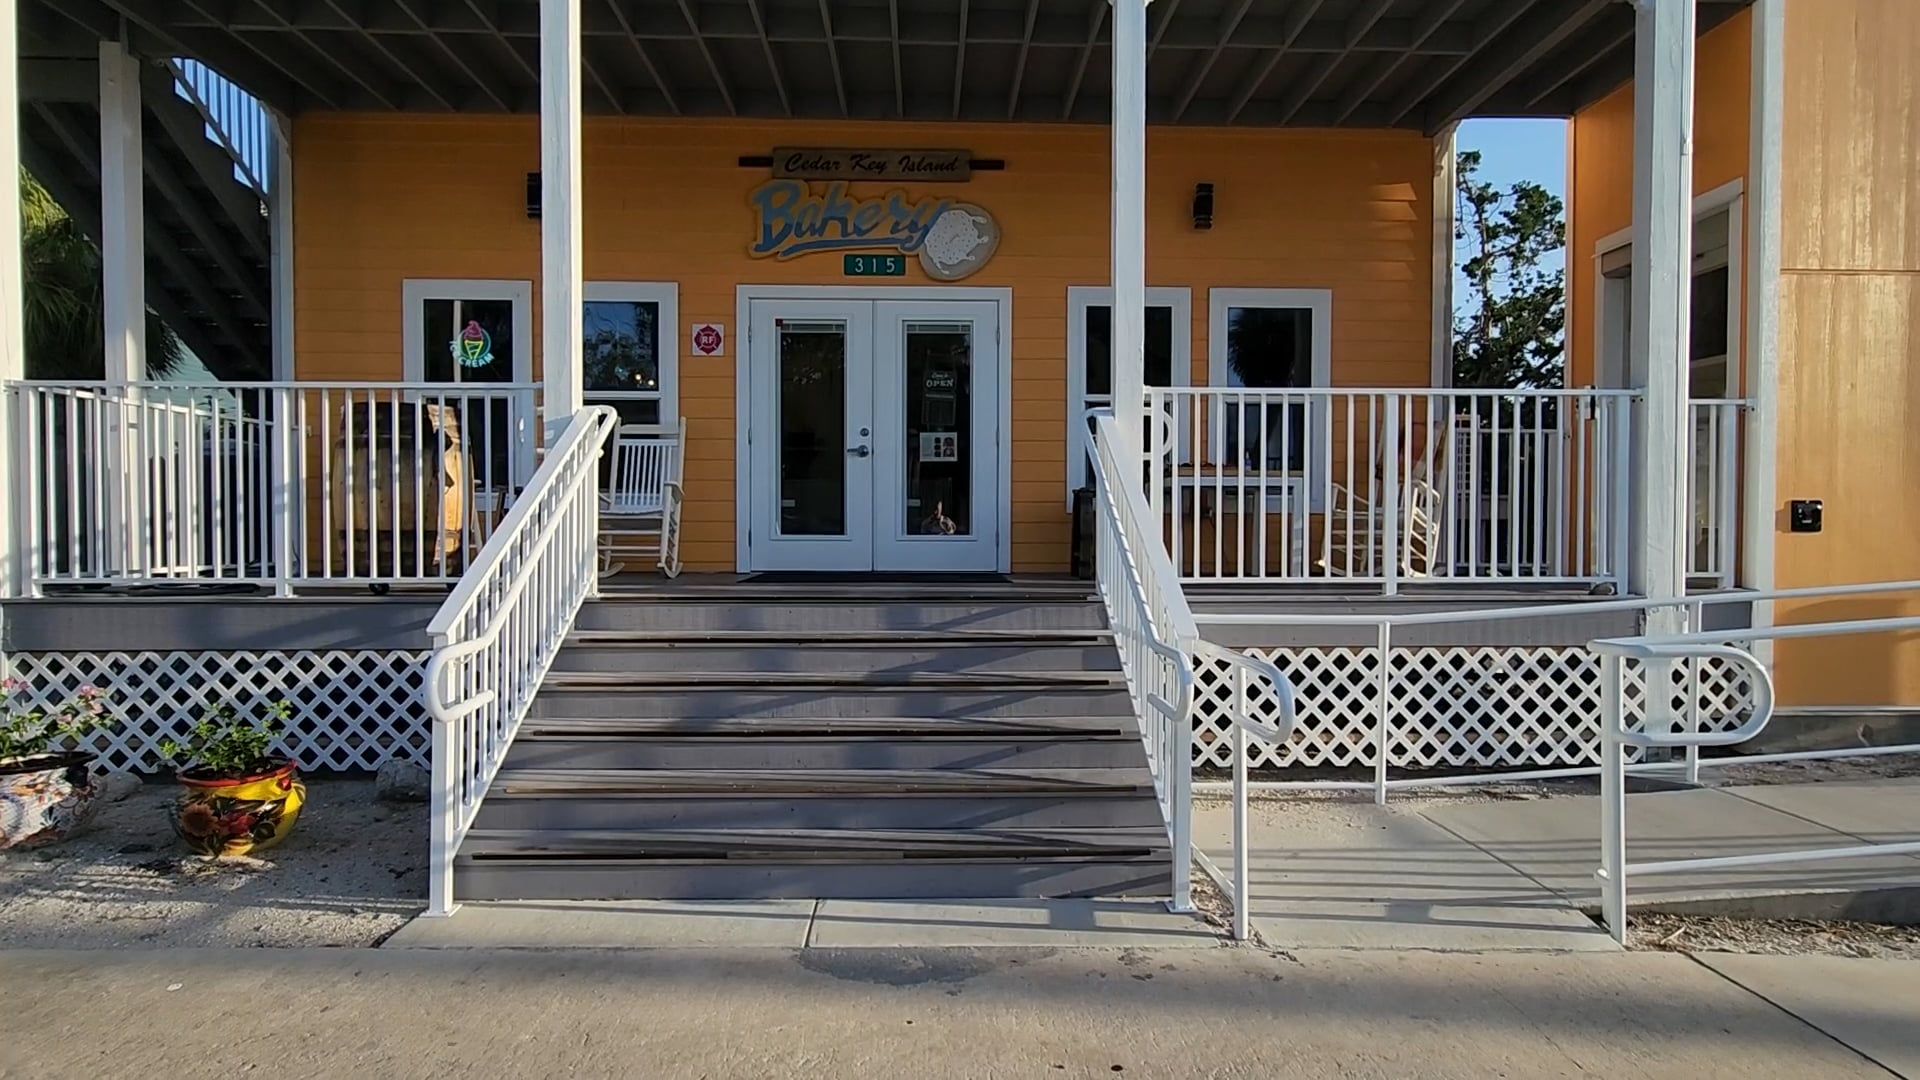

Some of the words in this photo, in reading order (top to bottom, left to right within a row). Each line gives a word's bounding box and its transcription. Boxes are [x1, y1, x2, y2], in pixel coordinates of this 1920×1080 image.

[785, 153, 841, 173] Cedar
[850, 153, 888, 174] Key
[899, 155, 959, 173] Island
[752, 182, 952, 254] Bakery
[854, 257, 896, 273] 315
[702, 335, 714, 345] RF
[458, 353, 495, 367] CREAM
[926, 379, 954, 387] OPEN
